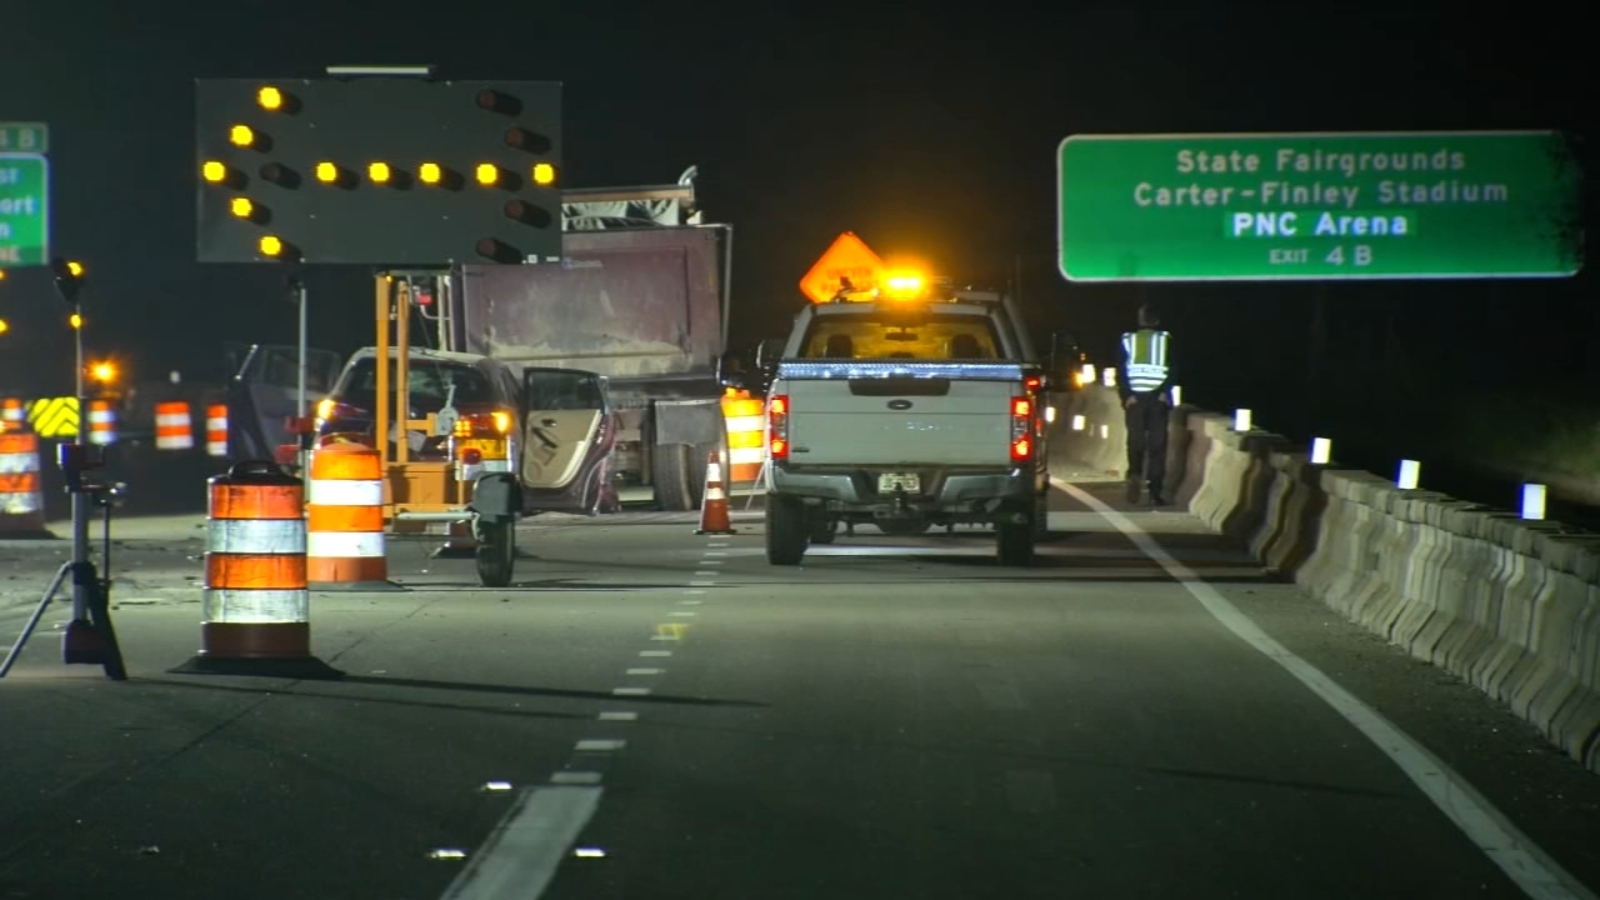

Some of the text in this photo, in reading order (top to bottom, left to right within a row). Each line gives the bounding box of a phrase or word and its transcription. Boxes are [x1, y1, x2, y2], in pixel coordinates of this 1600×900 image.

[1176, 148, 1466, 178] State Fairgrounds
[1134, 179, 1508, 209] Carter-Finley Stadium
[1233, 211, 1408, 237] PNC Arena
[1269, 249, 1308, 266] EXIT
